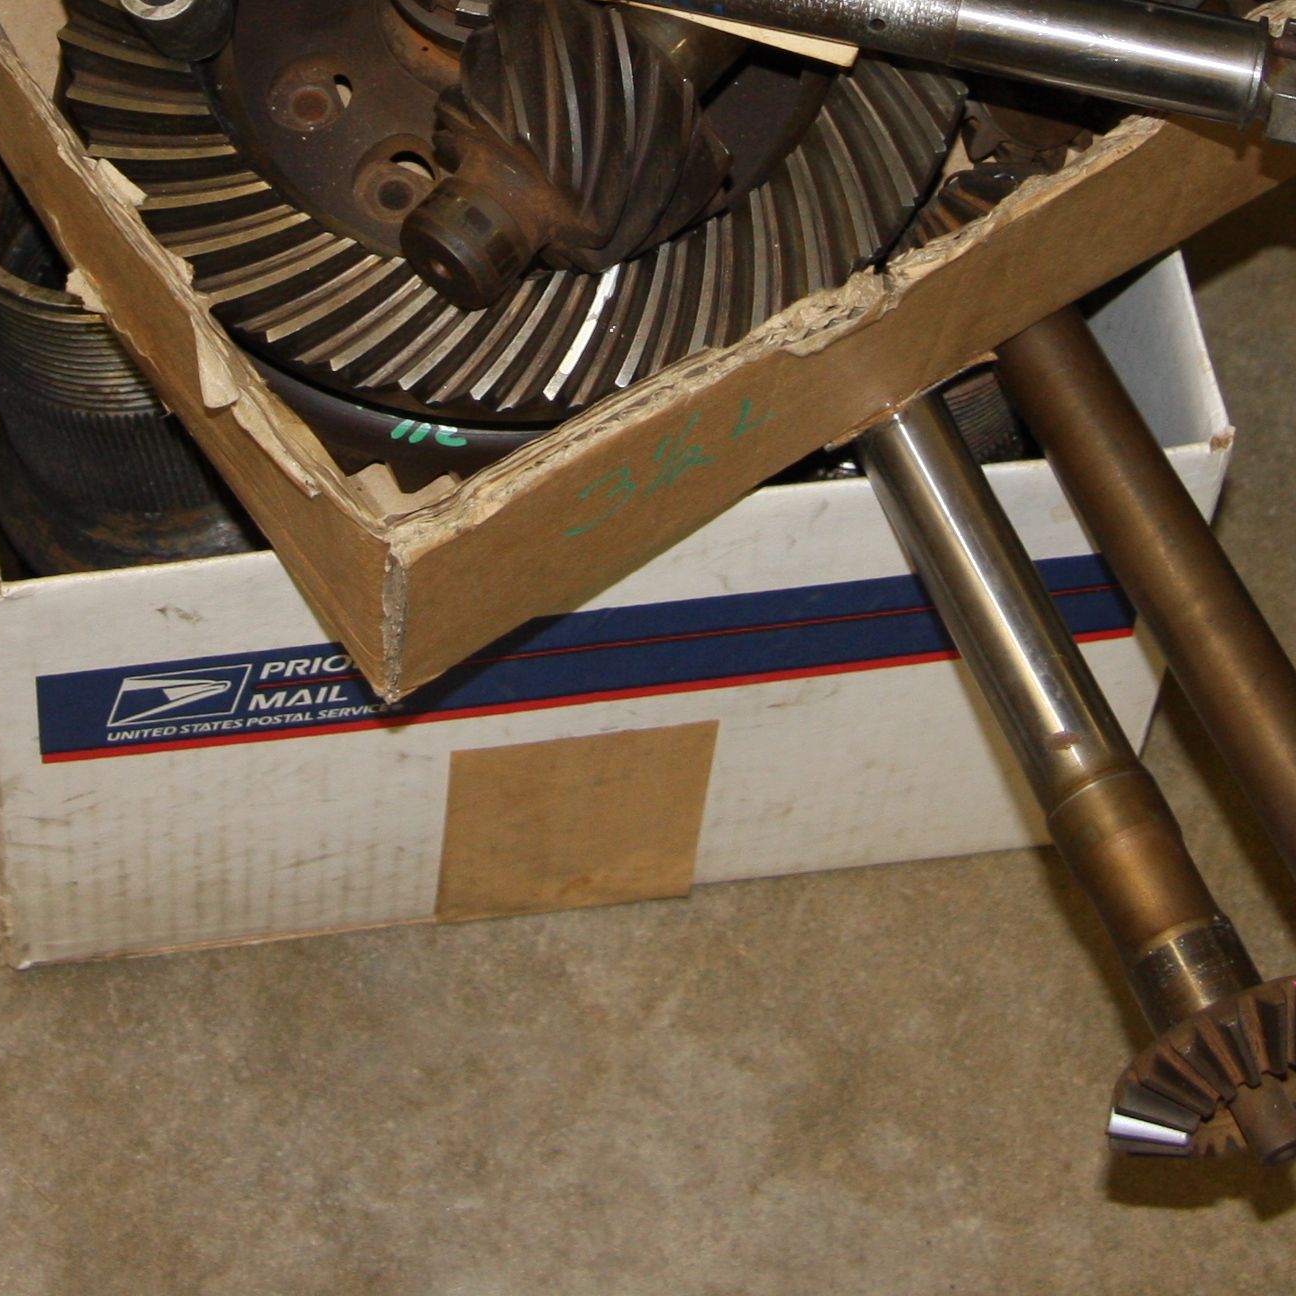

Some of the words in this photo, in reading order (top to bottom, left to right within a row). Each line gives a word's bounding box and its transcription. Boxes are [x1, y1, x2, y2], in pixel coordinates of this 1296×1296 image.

[260, 654, 356, 680] PRIO
[248, 685, 349, 712] MAIL
[106, 726, 177, 742] UNITED
[179, 719, 244, 734] STATES
[245, 713, 313, 728] POSTAL
